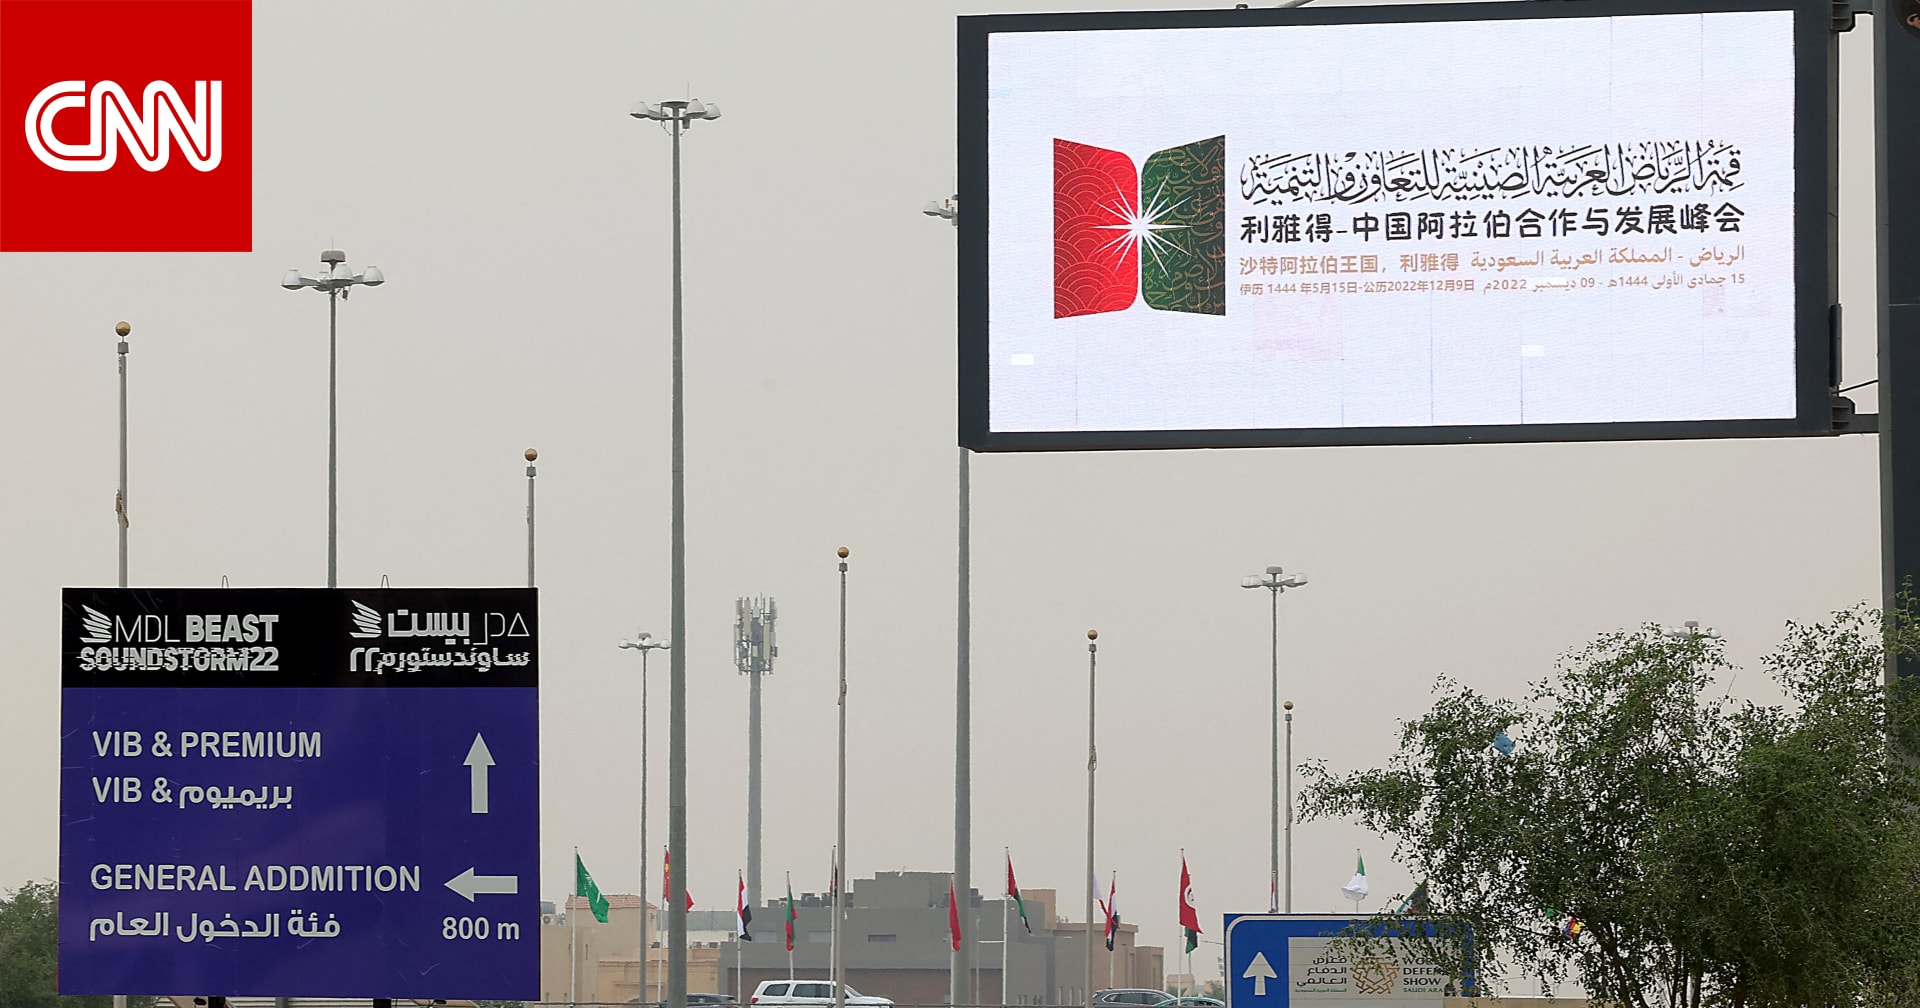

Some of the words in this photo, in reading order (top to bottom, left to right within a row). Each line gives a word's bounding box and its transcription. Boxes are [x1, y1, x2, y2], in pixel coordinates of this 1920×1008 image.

[1240, 202, 1746, 244] 利雅得-中国阿拉伯合作与发展峰会
[1471, 250, 1544, 272] السعودية
[1551, 249, 1602, 270] العربية
[1608, 247, 1672, 265] المملكة
[1690, 245, 1745, 267] الرياض
[1580, 277, 1596, 289] 09
[1731, 273, 1745, 284] 15
[115, 614, 180, 643] MDL
[185, 613, 280, 643] BEAST
[77, 646, 280, 672] SOUNDSTORM22
[92, 731, 142, 758] VIB
[151, 731, 173, 758] &
[180, 731, 323, 758] PREMIUM
[92, 777, 142, 803] VIB
[151, 777, 173, 803] &
[179, 784, 294, 810] بريميوم
[90, 864, 237, 892] GENERAL
[244, 864, 421, 893] ADDMITION
[88, 912, 170, 942] العام
[176, 913, 280, 943] الدخول
[287, 910, 342, 939] فئة
[441, 916, 491, 941] 800
[497, 922, 521, 941] m
[1306, 966, 1347, 977] الدفاع
[1403, 977, 1441, 986] SHOW
